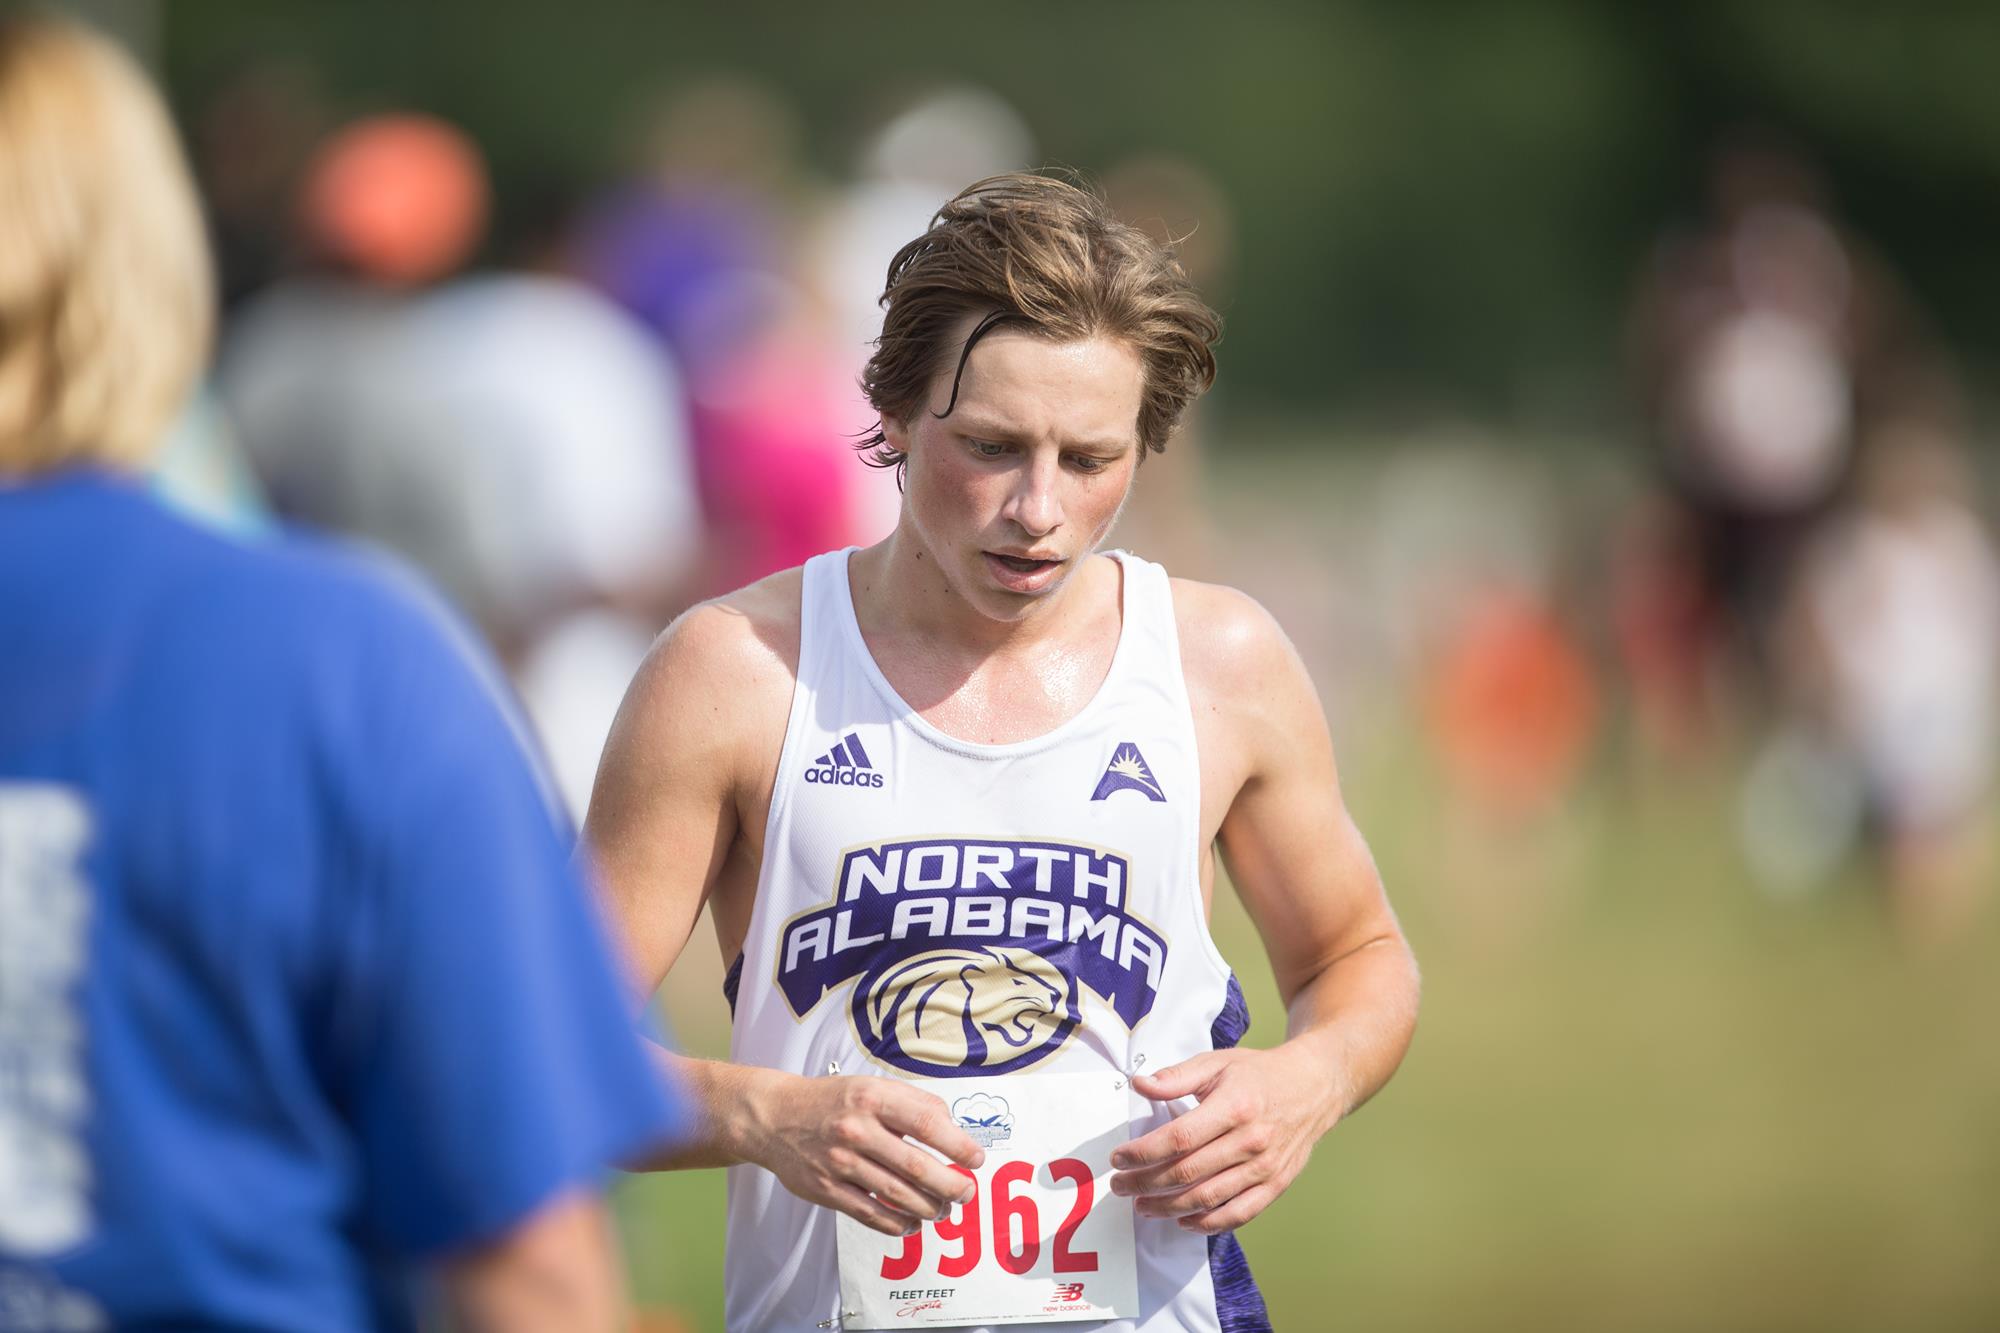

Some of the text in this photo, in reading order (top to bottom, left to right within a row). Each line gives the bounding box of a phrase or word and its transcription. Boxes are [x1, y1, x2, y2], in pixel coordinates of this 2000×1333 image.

[804, 765, 884, 789] adidas
[844, 845, 1122, 907] NORTH
[785, 896, 1165, 993] ALABAMA
[889, 1288, 956, 1300] FLEET FEET
[1060, 1304, 1091, 1312] balance
